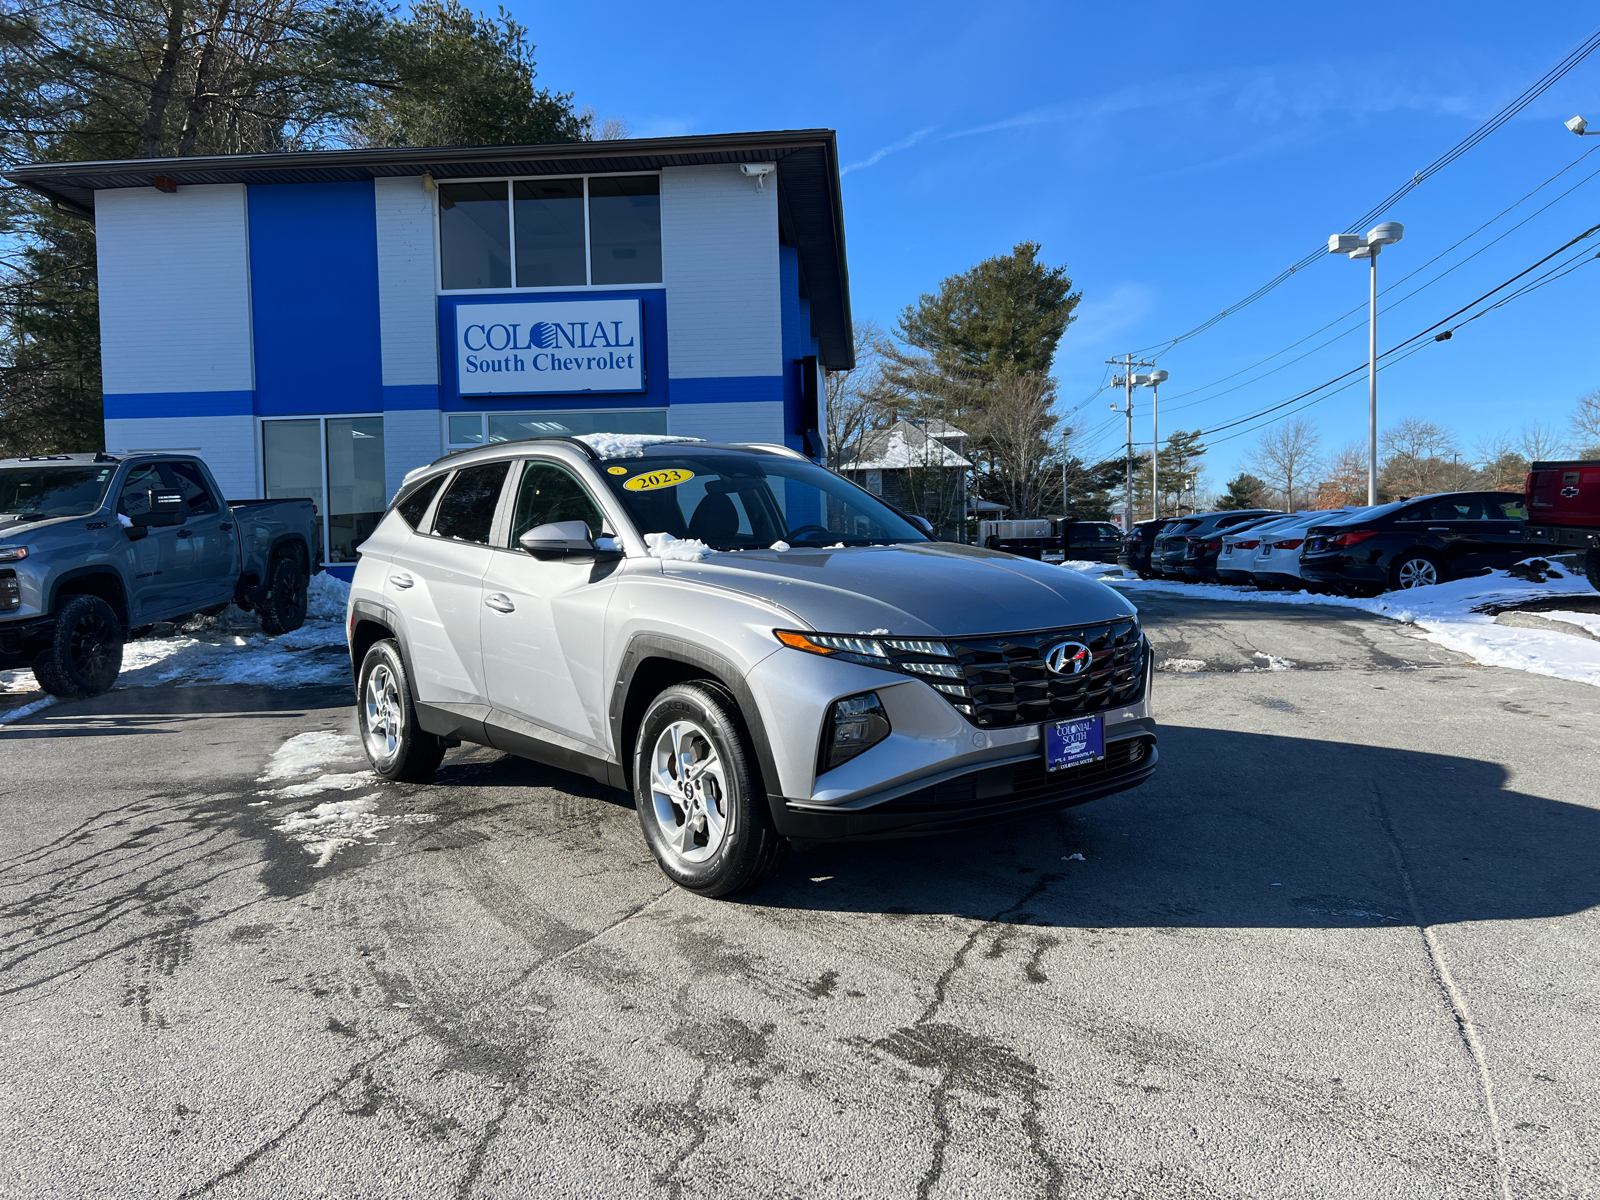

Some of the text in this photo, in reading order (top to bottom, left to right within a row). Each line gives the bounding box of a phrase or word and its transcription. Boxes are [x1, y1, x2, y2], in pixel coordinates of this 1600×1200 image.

[463, 321, 635, 351] COLONIAL
[466, 352, 635, 373] South Chevrolet
[637, 470, 682, 489] 2023
[1057, 722, 1092, 736] COLONIAL
[1063, 731, 1087, 744] SOUTH
